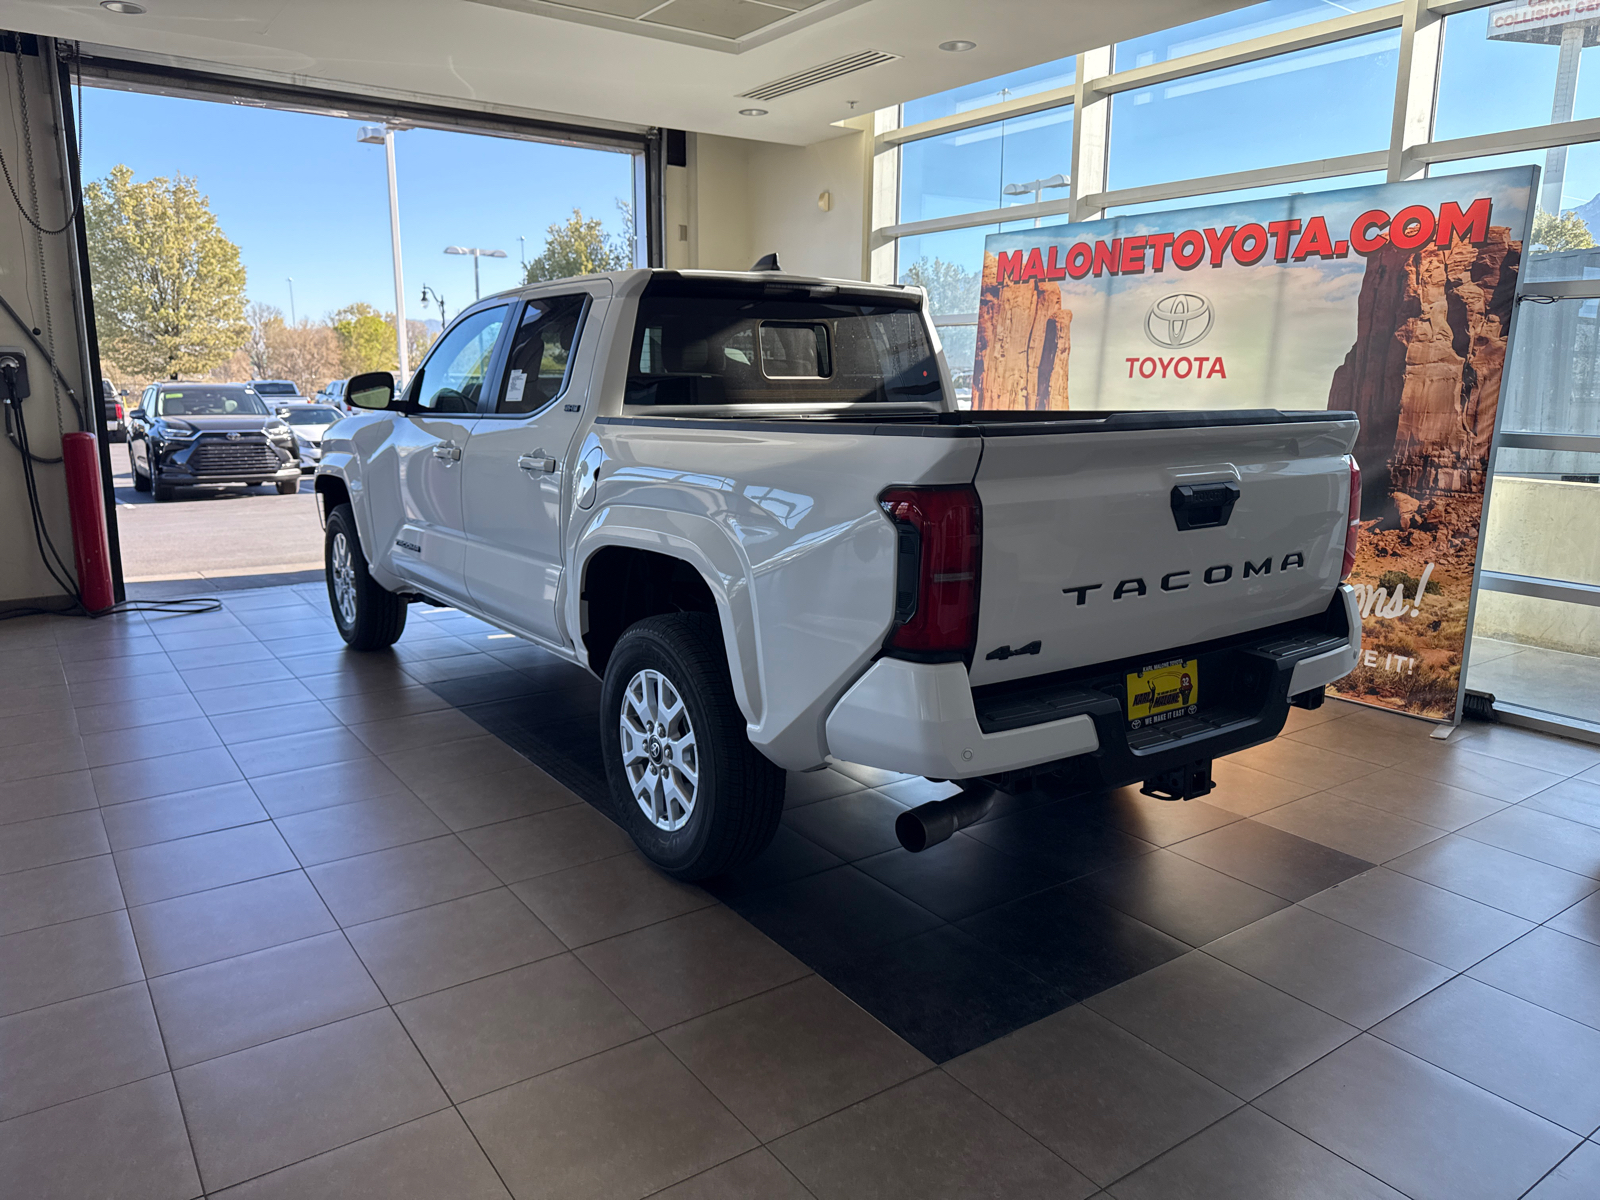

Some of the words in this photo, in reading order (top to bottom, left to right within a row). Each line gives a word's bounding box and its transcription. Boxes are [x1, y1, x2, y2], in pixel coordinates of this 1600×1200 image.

[1494, 4, 1571, 28] COLLISION
[996, 198, 1493, 284] MALONETOYOTA.COM
[1126, 356, 1227, 379] TOYOTA
[1061, 552, 1305, 606] TACOMA
[1142, 664, 1153, 672] KARL
[1385, 653, 1415, 675] IT!
[1182, 677, 1190, 686] 32
[1144, 717, 1153, 725] WE
[1153, 713, 1167, 723] MAKE
[1167, 711, 1172, 719] IT
[1173, 709, 1185, 718] EASY
